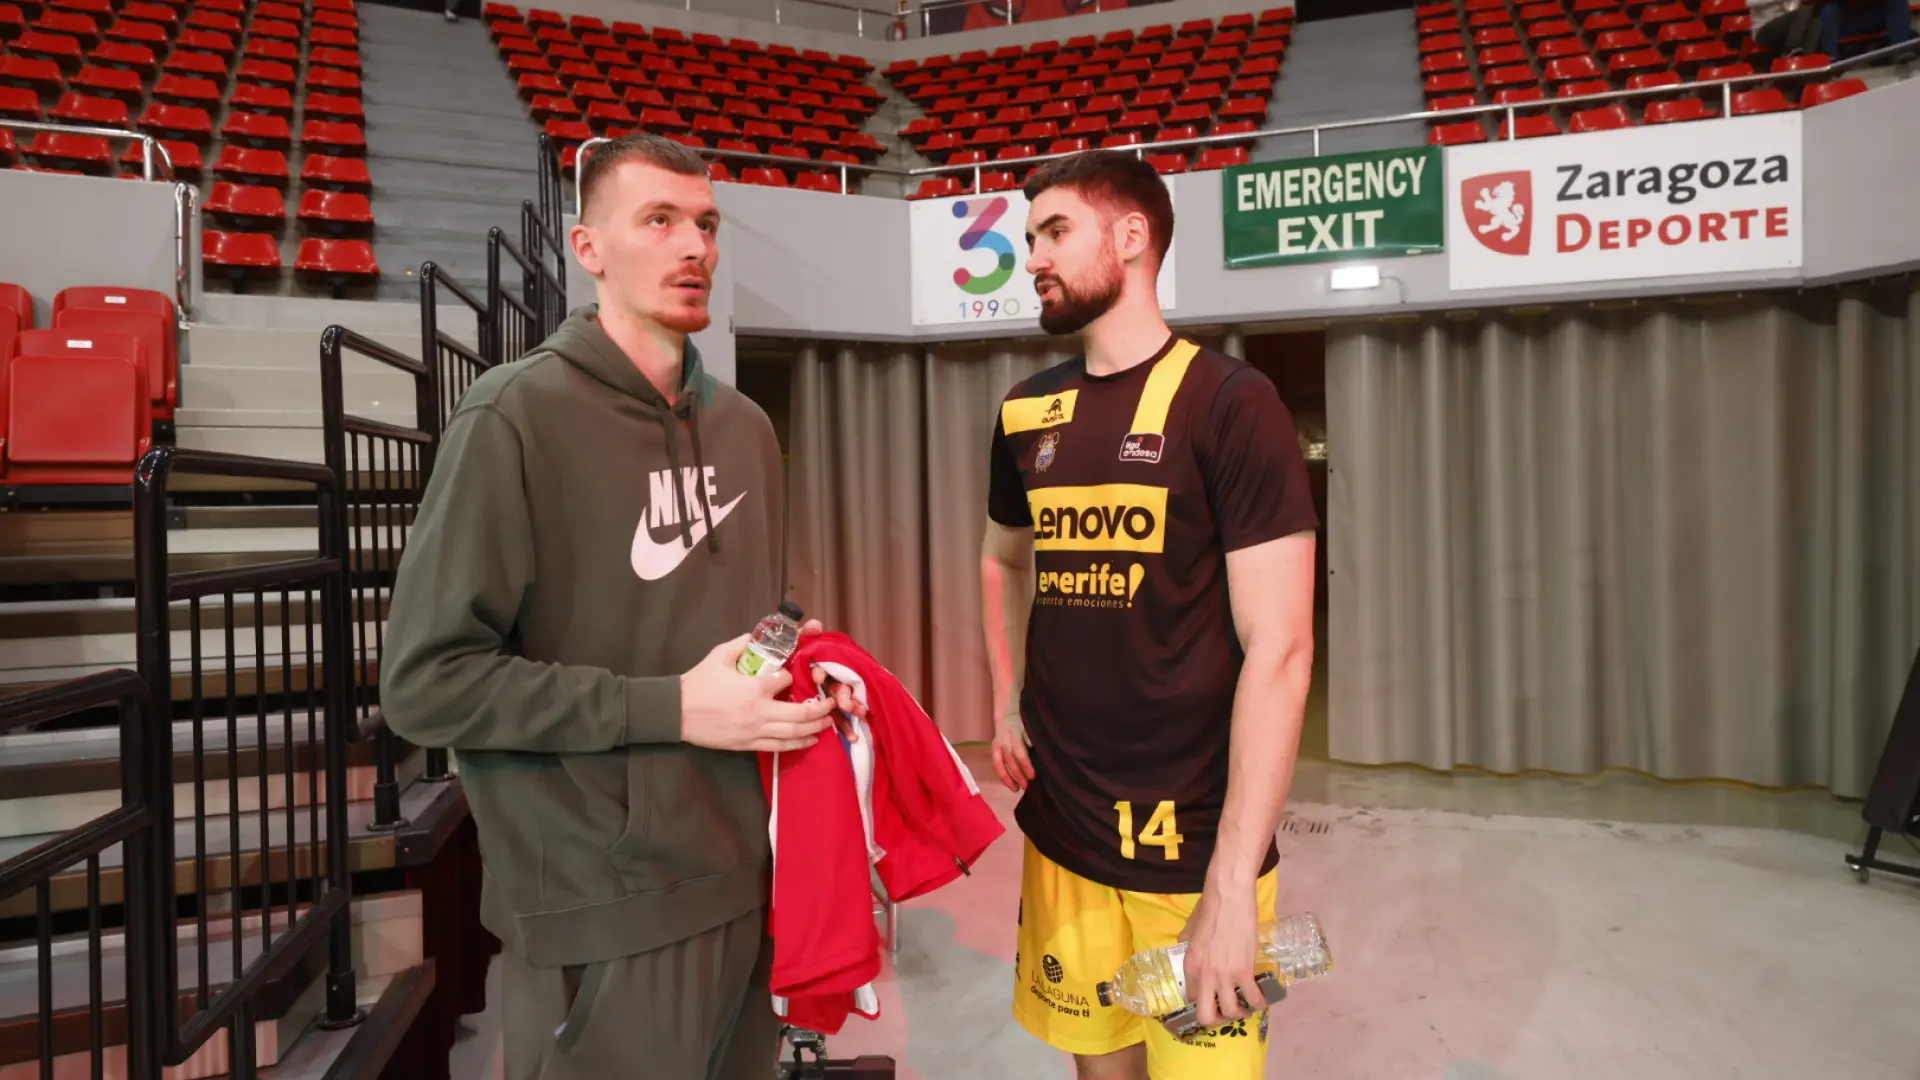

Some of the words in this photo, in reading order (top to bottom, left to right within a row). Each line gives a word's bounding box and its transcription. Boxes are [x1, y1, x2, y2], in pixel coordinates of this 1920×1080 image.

[1237, 156, 1427, 212] EMERGENCY
[1556, 154, 1789, 204] Zaragoza
[1278, 209, 1384, 254] EXIT
[1556, 206, 1789, 253] DEPORTE
[958, 298, 1021, 319] 1990
[1067, 597, 1124, 609] emociones
[1114, 800, 1184, 860] 14
[1041, 979, 1090, 1007] LAGUNA
[1057, 1004, 1080, 1017] para
